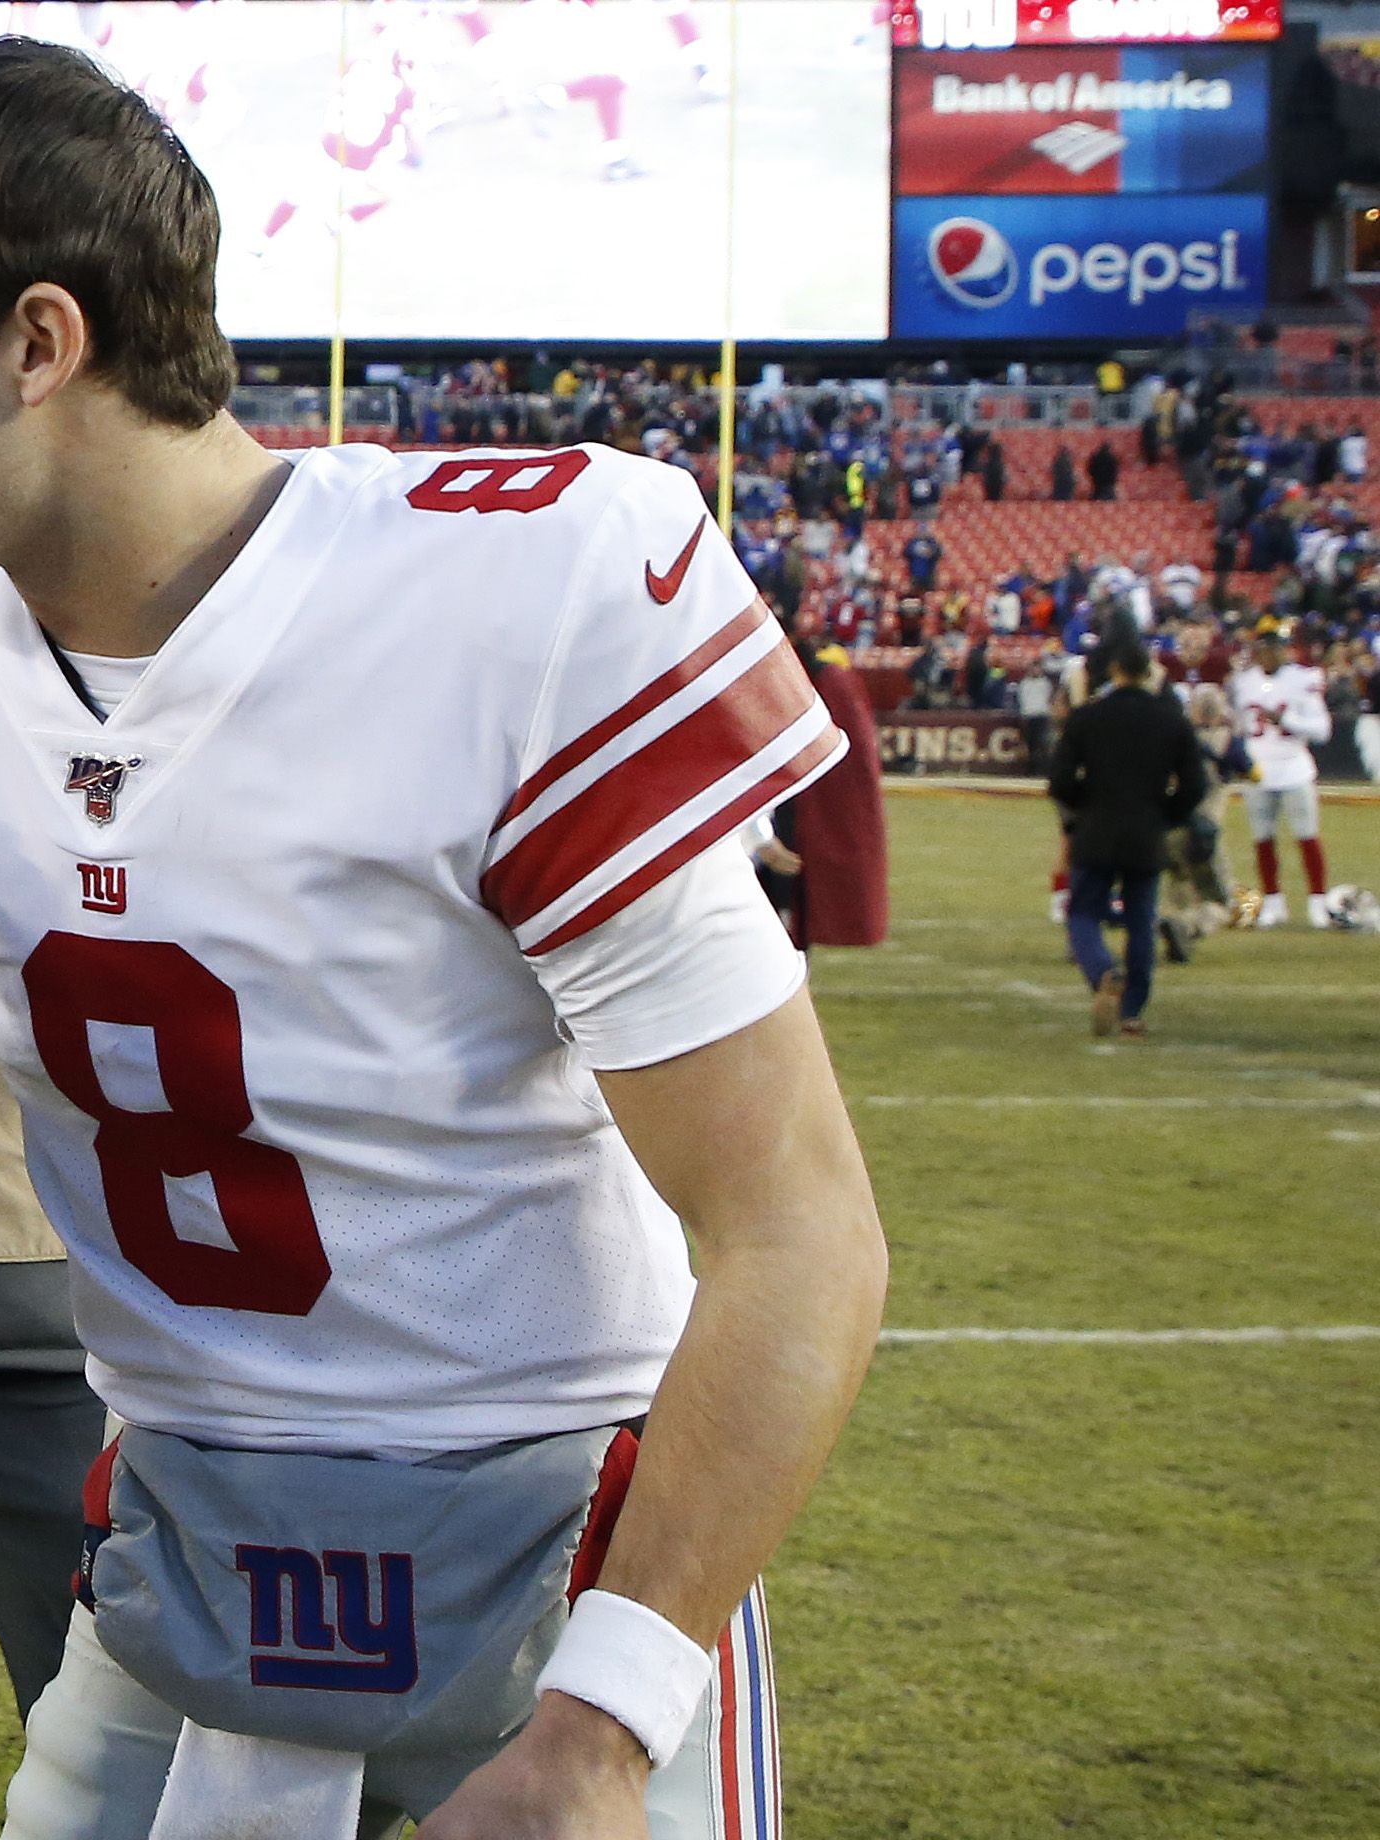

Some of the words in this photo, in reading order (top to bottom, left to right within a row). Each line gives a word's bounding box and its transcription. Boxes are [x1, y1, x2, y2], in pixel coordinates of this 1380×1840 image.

[932, 74, 1028, 113] Bank
[1030, 72, 1071, 112] of
[1073, 72, 1232, 111] America
[1030, 228, 1239, 306] pepsi
[21, 929, 333, 1317] 8
